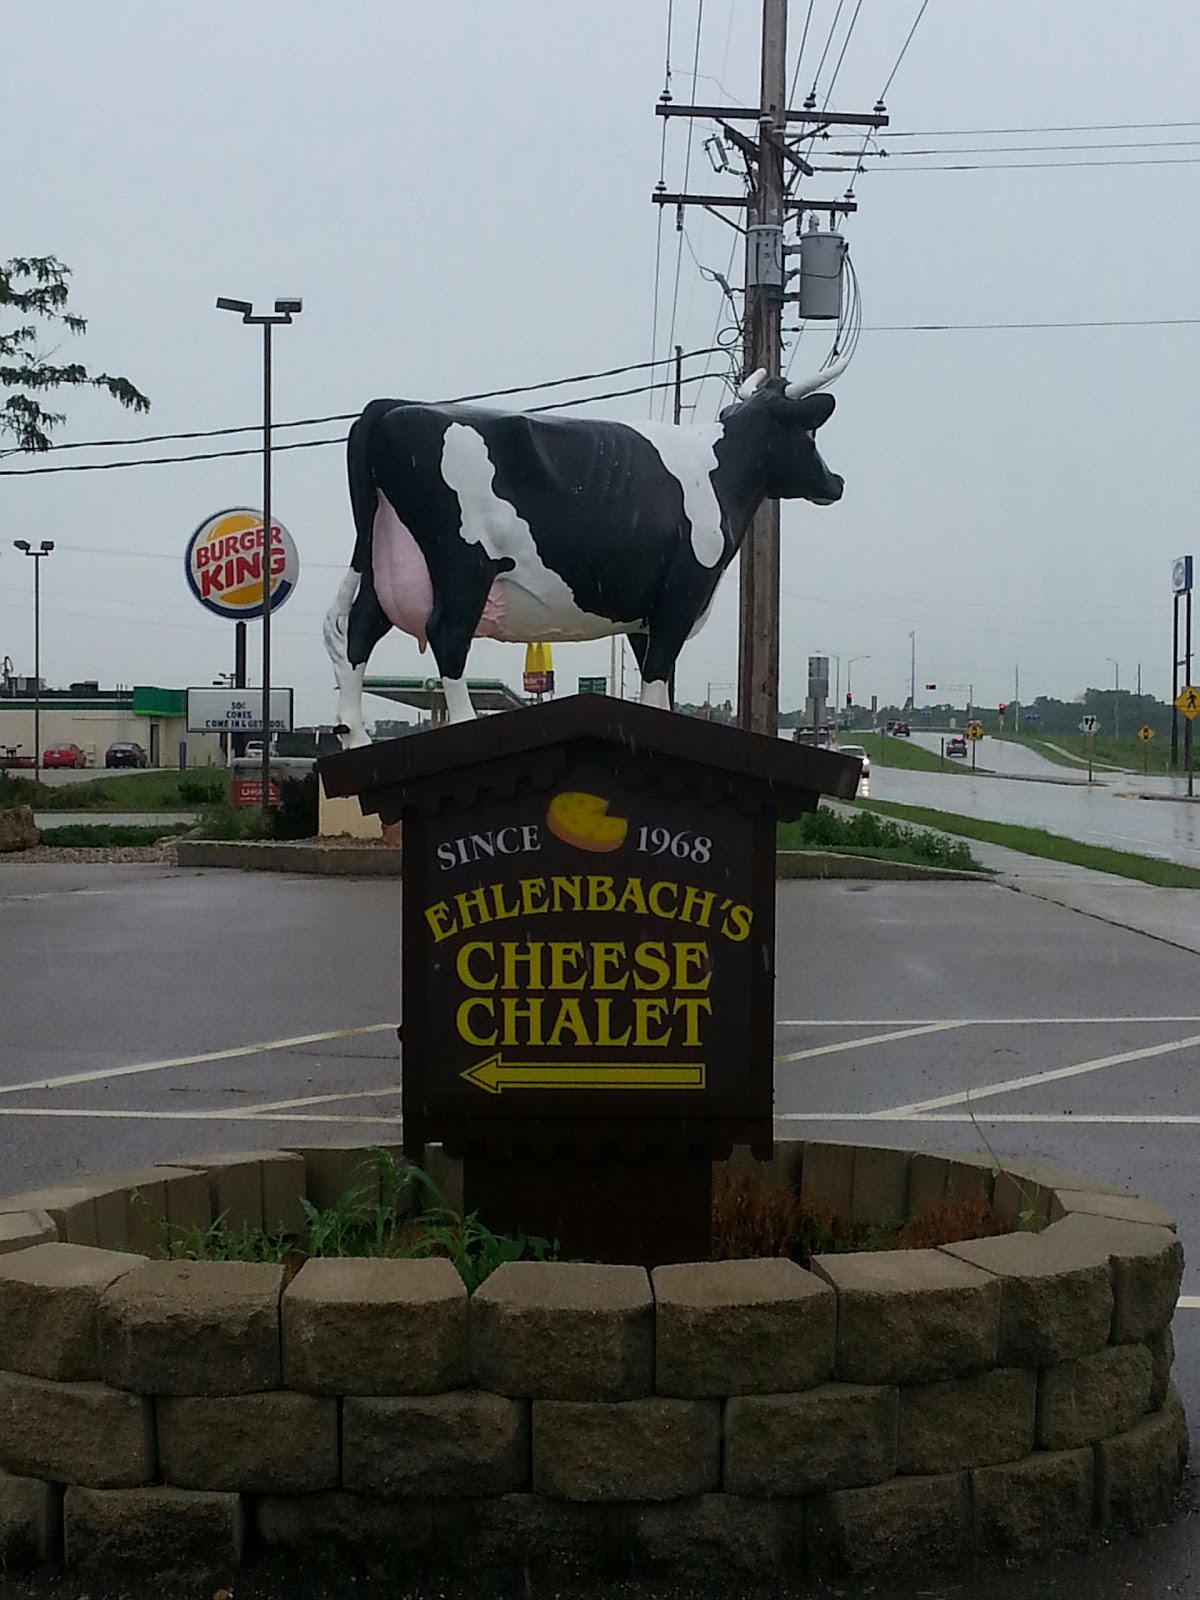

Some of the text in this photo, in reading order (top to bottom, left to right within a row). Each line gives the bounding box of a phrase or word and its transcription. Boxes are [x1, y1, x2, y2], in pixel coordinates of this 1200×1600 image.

[196, 527, 282, 569] BURGER
[201, 548, 285, 597] KING
[264, 720, 285, 728] OOL
[436, 824, 713, 871] SINCE 1968
[424, 875, 755, 943] EHLENBACH'S
[456, 940, 713, 991] CHEESE
[456, 997, 713, 1047] CHALET
